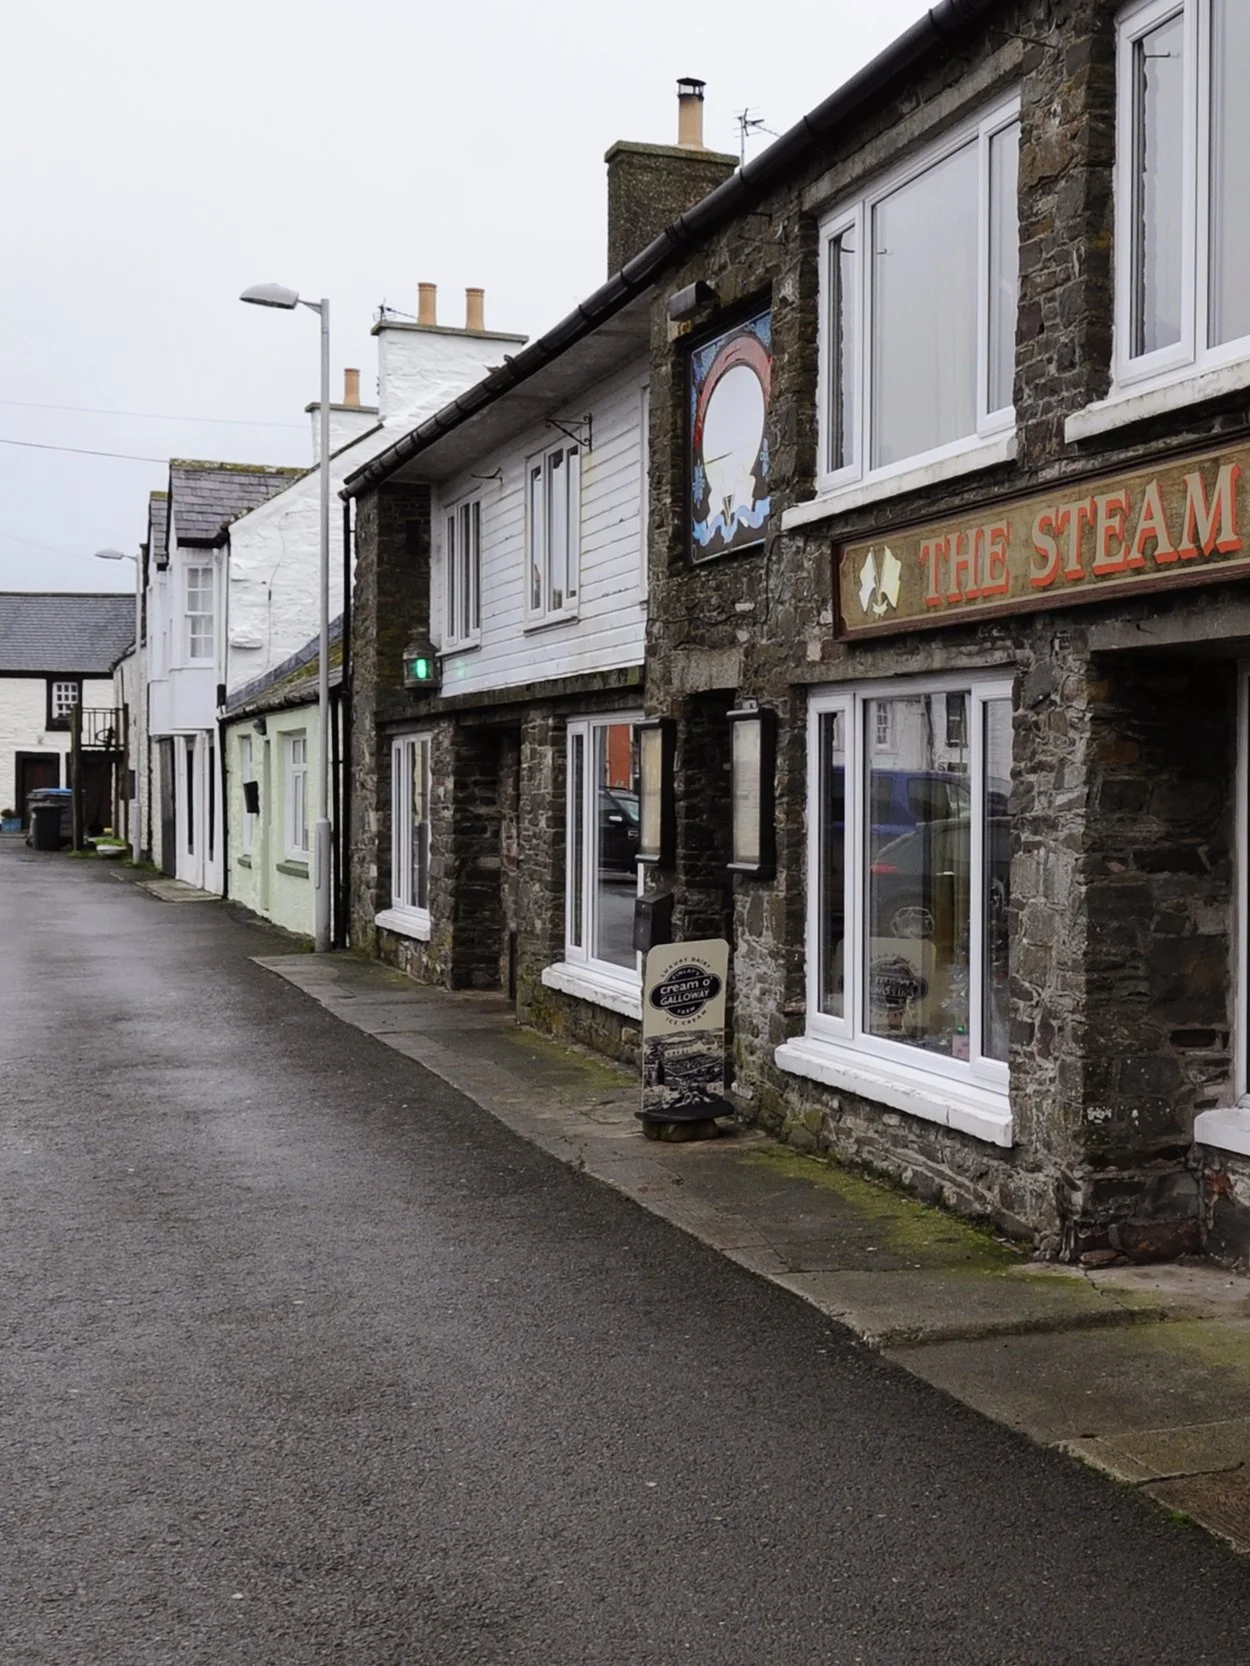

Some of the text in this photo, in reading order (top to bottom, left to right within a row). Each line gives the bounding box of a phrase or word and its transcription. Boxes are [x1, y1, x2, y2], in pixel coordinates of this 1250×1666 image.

[919, 519, 1011, 607] THE
[1028, 462, 1243, 588] STEAM
[660, 980, 699, 994] cream
[660, 989, 709, 1005] GALLOWAY
[666, 1009, 707, 1026] ICE CREAM
